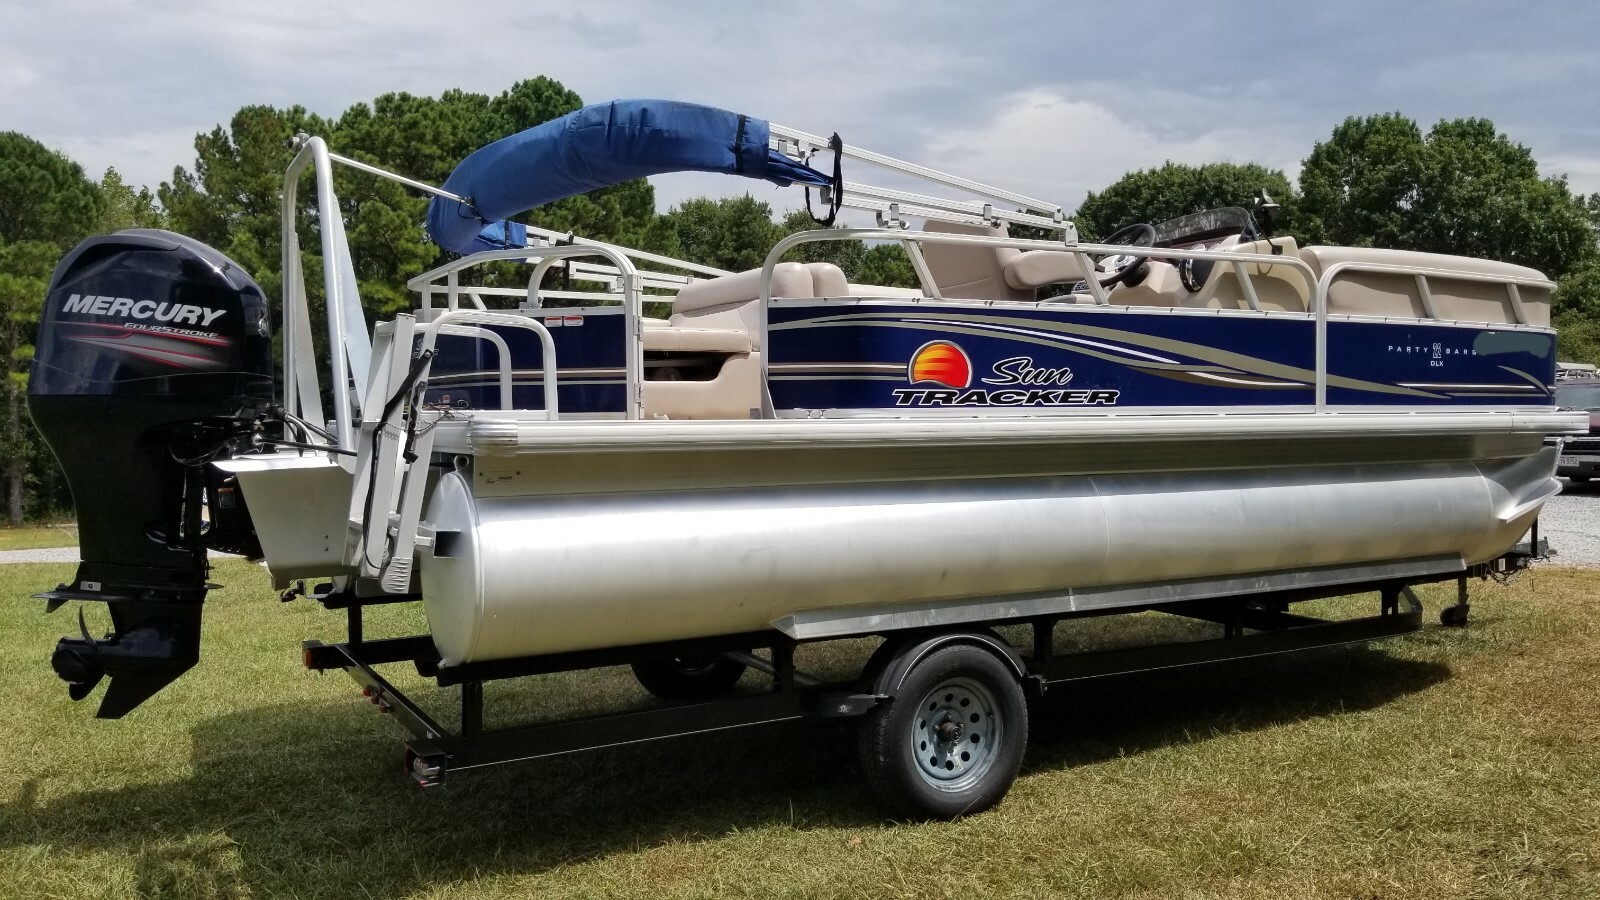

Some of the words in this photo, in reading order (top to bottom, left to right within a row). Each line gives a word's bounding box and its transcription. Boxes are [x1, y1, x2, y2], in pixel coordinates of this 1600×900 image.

[63, 294, 227, 326] MERCURY
[123, 322, 219, 339] FOURSTROKE
[1388, 345, 1428, 353] PARTY
[1446, 348, 1477, 356] BARG
[981, 357, 1073, 385] Sun
[892, 389, 1120, 405] TRACKER
